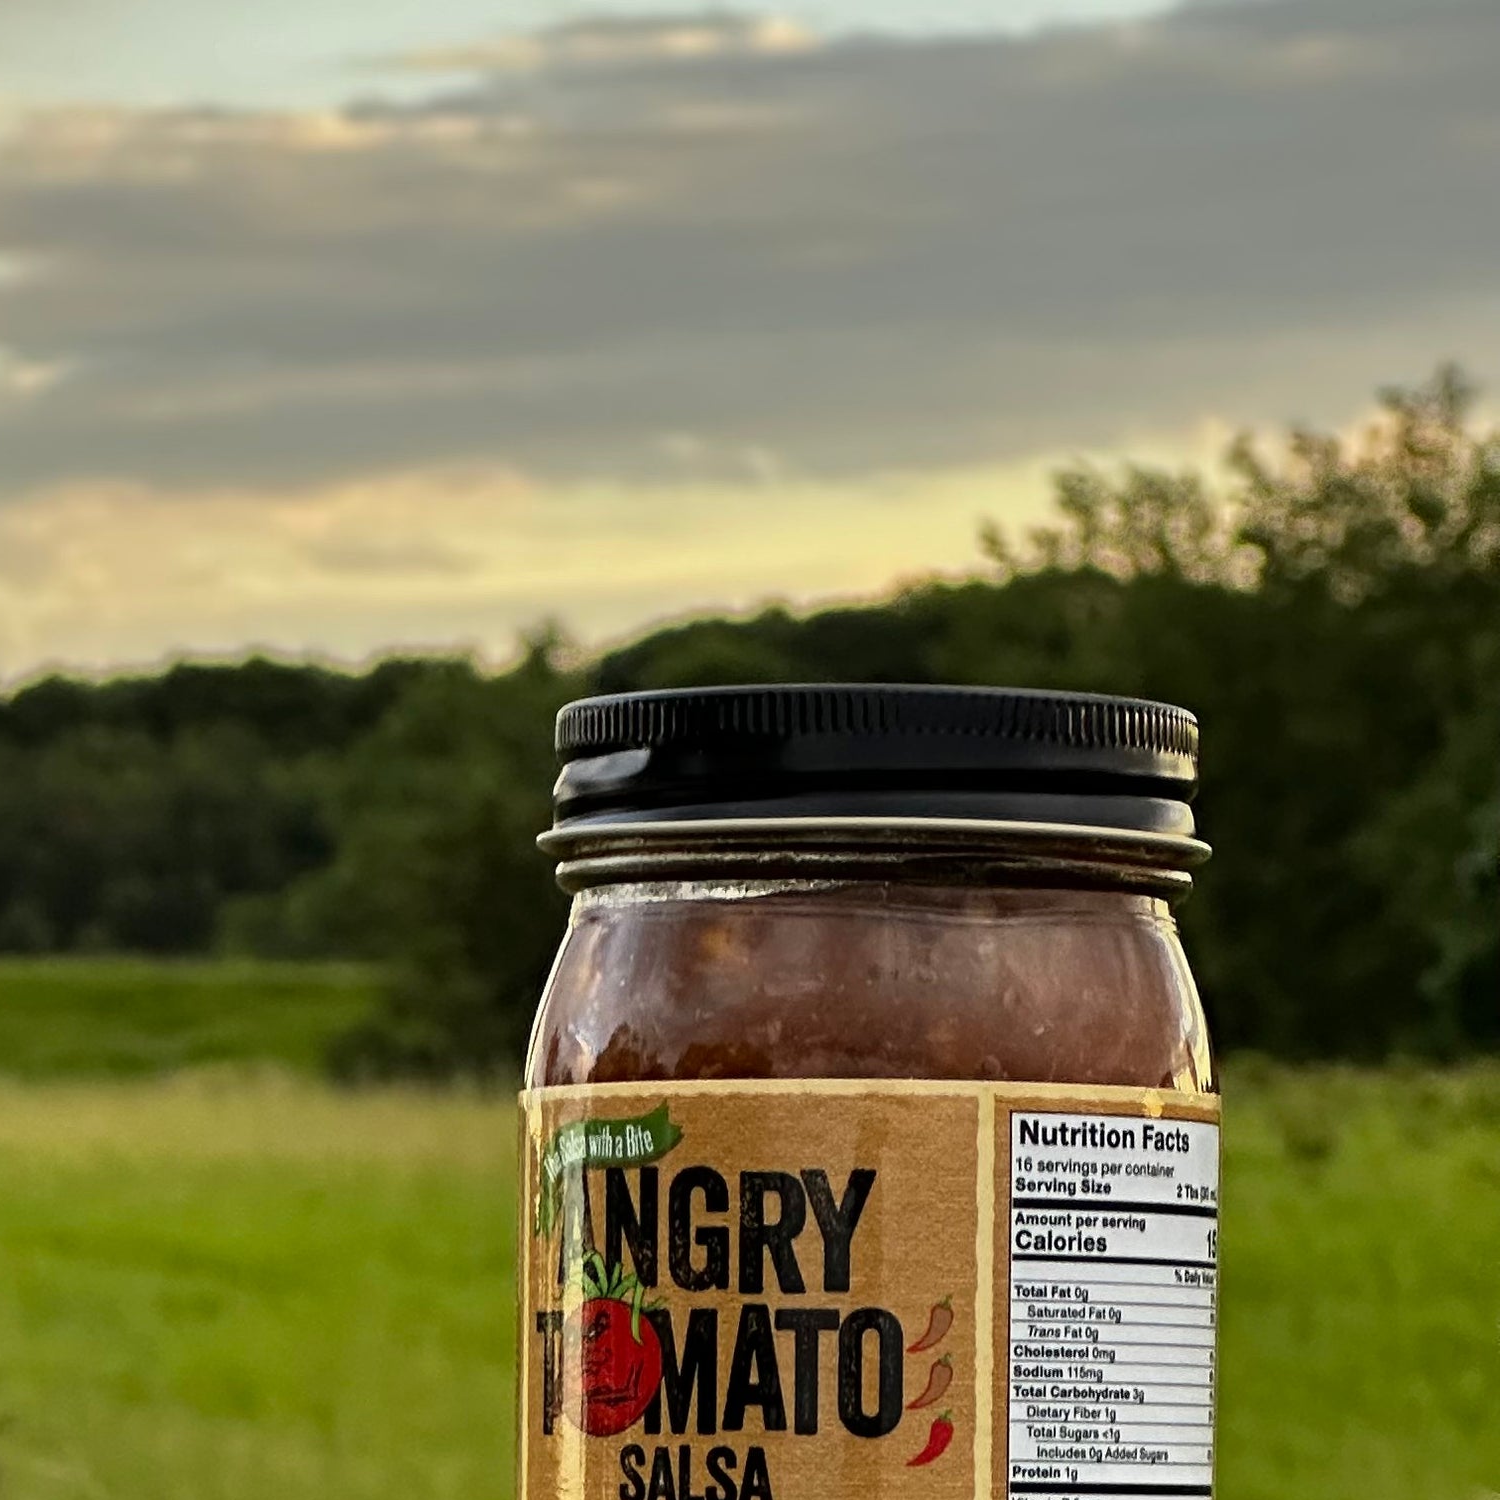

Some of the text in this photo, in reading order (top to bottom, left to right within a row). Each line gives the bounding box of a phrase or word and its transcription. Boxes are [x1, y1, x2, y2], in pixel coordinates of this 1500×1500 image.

[1019, 1119, 1189, 1152] Nutrition Facts
[560, 1129, 586, 1167] Salsa
[589, 1124, 613, 1158] with
[615, 1135, 623, 1158] a
[626, 1124, 654, 1158] Bite
[1016, 1157, 1174, 1178] 16 servings per container
[1016, 1178, 1076, 1196] Serving
[1081, 1179, 1111, 1194] Size
[558, 1166, 877, 1294] ANGRY
[1015, 1211, 1146, 1231] Amount per serving
[1015, 1229, 1107, 1251] Calories
[1014, 1285, 1089, 1302] Total Fat 0g
[1027, 1305, 1122, 1323] Saturated Fat 0g
[1028, 1325, 1099, 1342] Trans Fat 0g
[1013, 1345, 1115, 1363] Cholesterol 0mg
[1013, 1365, 1063, 1379] Sodium
[1013, 1385, 1046, 1398] Total
[1050, 1386, 1130, 1402] Carbohydrate
[1026, 1406, 1116, 1423] Dietary Fiber 1g
[1026, 1425, 1056, 1438] Total
[1059, 1427, 1099, 1442] Sugars
[1036, 1446, 1168, 1464] Includes 0g Added Sugars
[1012, 1466, 1078, 1482] Protein 1g
